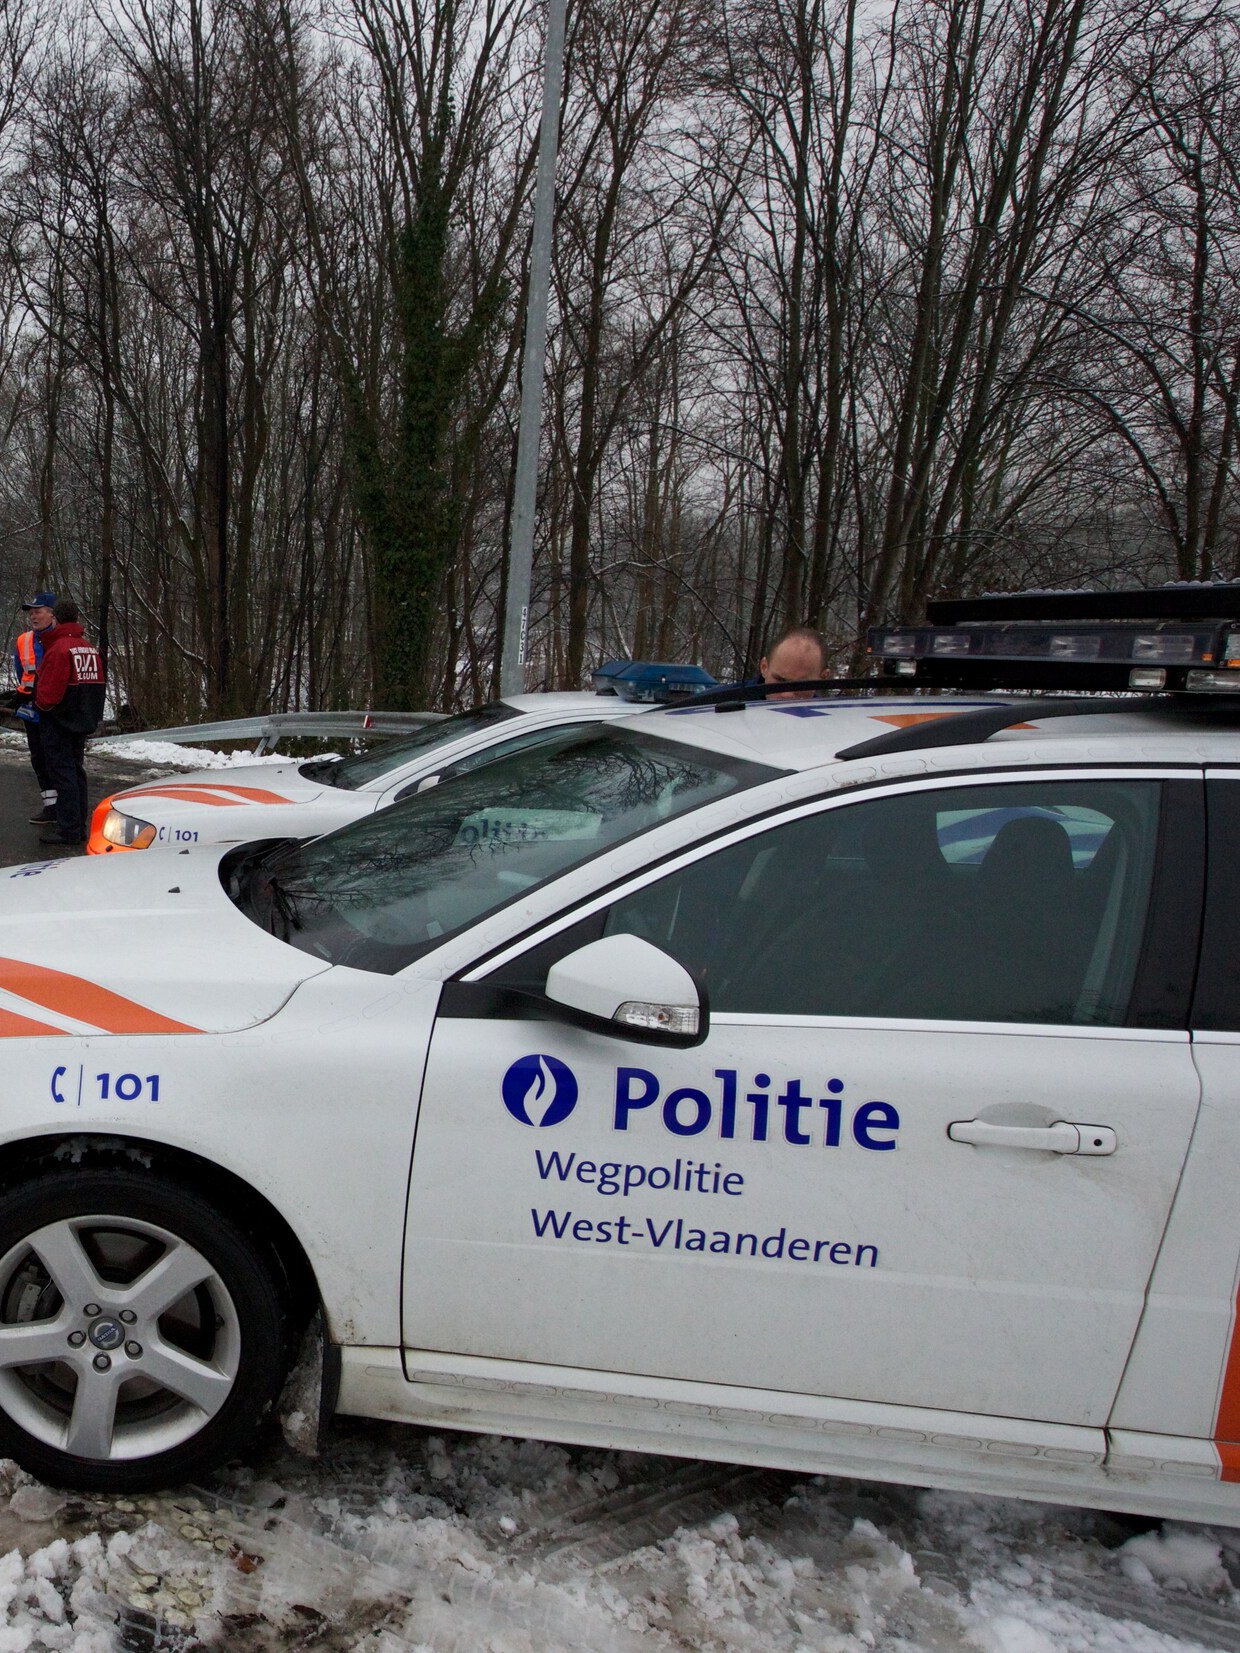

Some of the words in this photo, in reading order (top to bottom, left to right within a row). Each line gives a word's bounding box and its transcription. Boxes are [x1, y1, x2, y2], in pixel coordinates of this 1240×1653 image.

[175, 829, 199, 842] 101
[97, 1072, 160, 1102] 101
[613, 1066, 900, 1151] Politie
[534, 1149, 745, 1197] Wegpolitie
[531, 1208, 879, 1267] West-Vlaanderen
